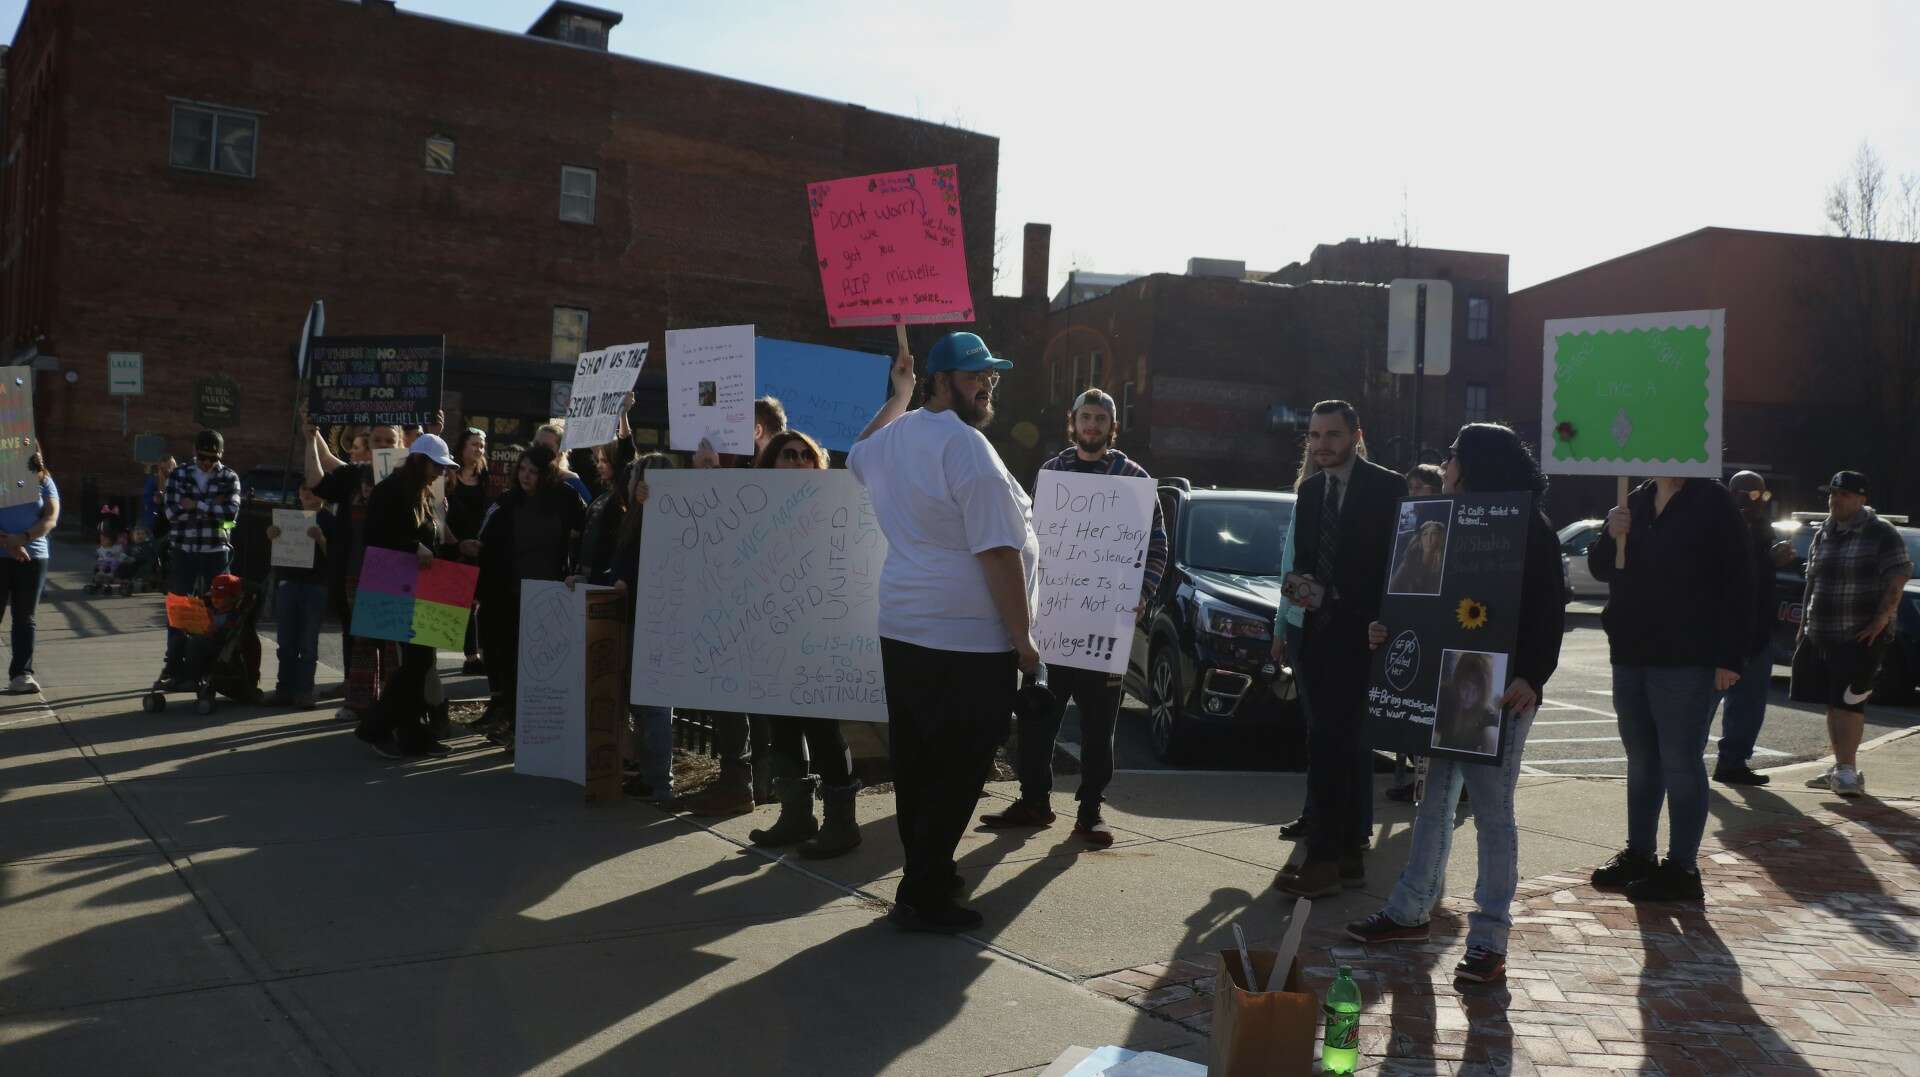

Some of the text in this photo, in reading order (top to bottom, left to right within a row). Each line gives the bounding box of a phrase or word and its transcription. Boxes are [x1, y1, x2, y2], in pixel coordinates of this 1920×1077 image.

[829, 201, 867, 231] Dont
[375, 412, 432, 425] MICHELLE
[1056, 482, 1120, 513] Dont
[1037, 518, 1147, 548] Let Her Story
[821, 505, 849, 621] UNITED
[1039, 541, 1063, 558] nd
[1065, 544, 1087, 561] In
[780, 547, 816, 593] OUT
[1038, 567, 1134, 591] Justice Is a
[769, 585, 823, 635] GFPD
[1039, 591, 1138, 617] ight Not a
[829, 655, 852, 668] TO
[791, 665, 877, 687] 3-6-2025
